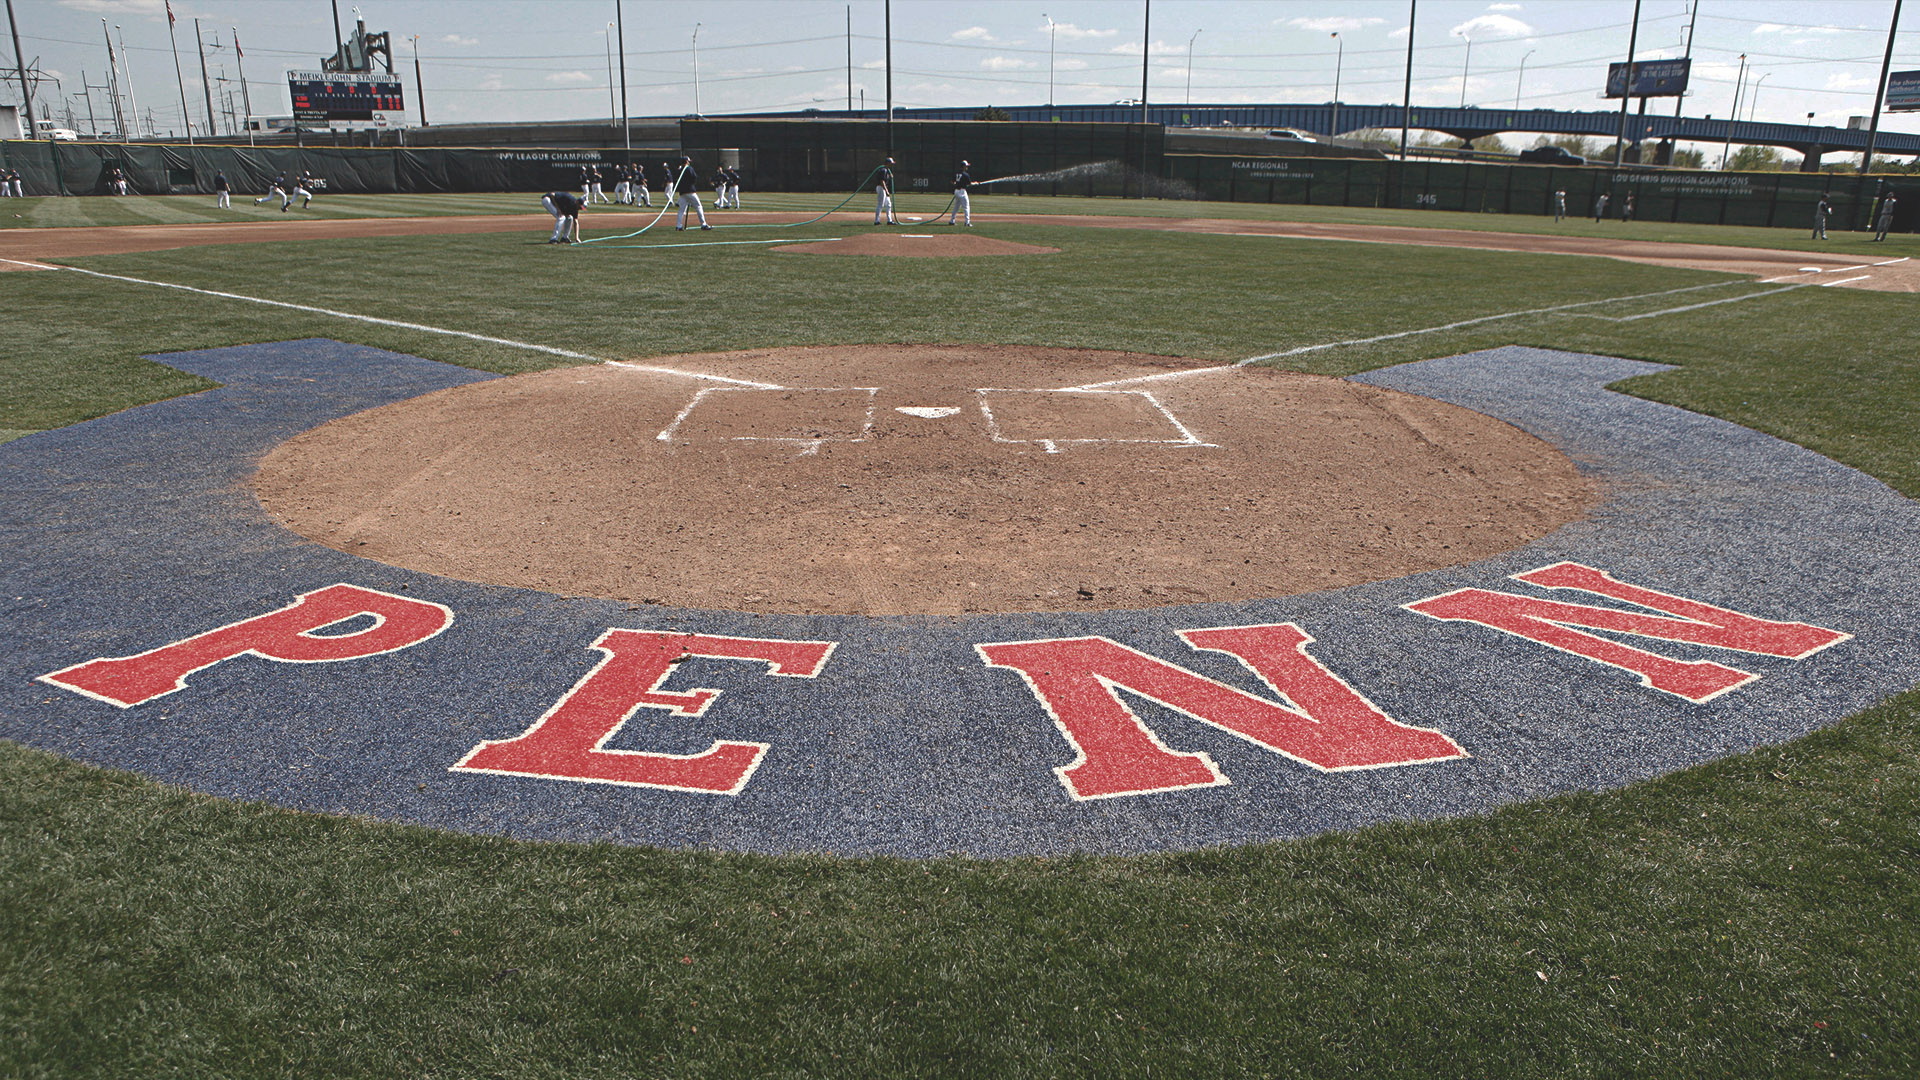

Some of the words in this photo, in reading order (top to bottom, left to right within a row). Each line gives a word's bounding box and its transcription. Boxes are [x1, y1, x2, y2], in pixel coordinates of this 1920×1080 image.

[300, 73, 352, 82] MEIKLEJOHN
[356, 75, 391, 83] STADIUM
[1231, 161, 1250, 169] NCAA
[1611, 173, 1628, 182] LOU
[1629, 174, 1659, 183] GEHRIG
[1660, 175, 1697, 184] DIVISION
[1699, 176, 1749, 185] CHAMPIONS
[1416, 193, 1437, 204] 345
